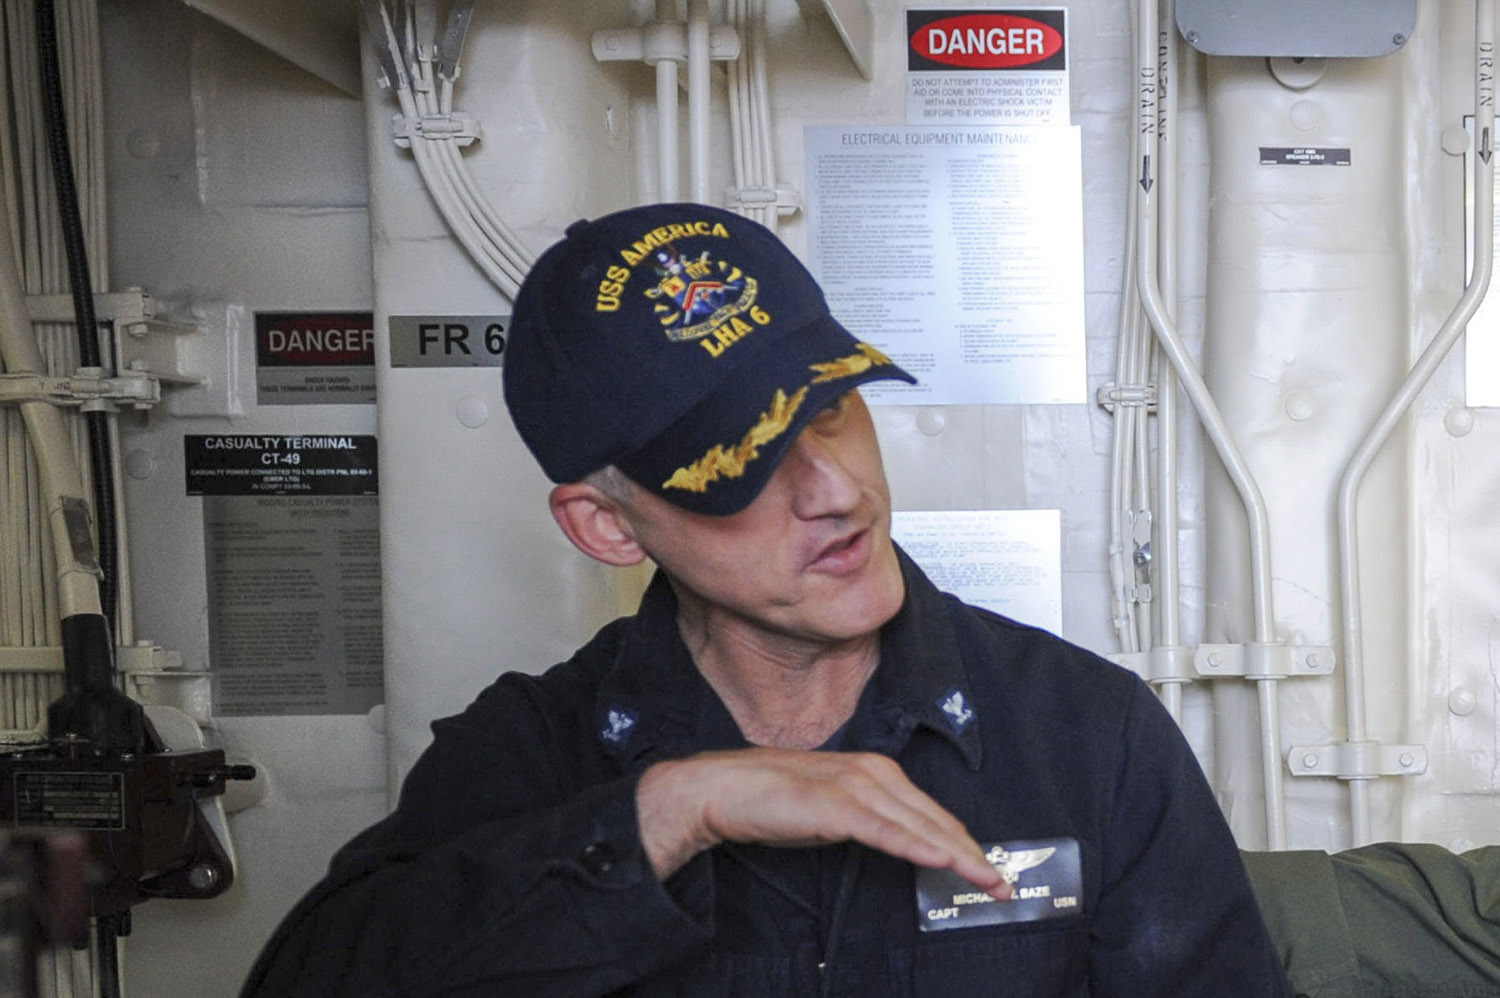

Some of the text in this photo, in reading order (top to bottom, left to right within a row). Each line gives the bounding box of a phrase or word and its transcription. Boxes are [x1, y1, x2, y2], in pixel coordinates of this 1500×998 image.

[928, 28, 1044, 55] DANGER
[912, 78, 1063, 87] DO NOT ATTEMPT TO ADMINISTER FIRST
[1480, 42, 1493, 107] DRAIN
[914, 88, 1062, 97] AID OR COME INTO PHYSICAL CONTACT
[925, 98, 1052, 106] WITH AN ELECTRIC SHOCK VICTIM
[1141, 66, 1155, 134] DRAIN
[923, 109, 954, 117] BEFORE
[957, 109, 970, 117] THE
[973, 109, 1005, 117] POWER
[1006, 109, 1012, 117] IS
[1013, 109, 1033, 117] SHUT
[842, 132, 901, 146] ELECTRICAL
[905, 132, 963, 146] EQUIPMENT
[595, 221, 730, 312] USS AMERICA
[419, 323, 505, 356] FR 6
[700, 317, 754, 358] LHA
[750, 305, 771, 325] 6
[205, 438, 356, 449] CASUALTY TERMINAL
[261, 453, 300, 465] CT-49
[953, 892, 996, 905] MICHA
[1020, 885, 1050, 899] BAZE
[928, 896, 1077, 920] CAPT USN
